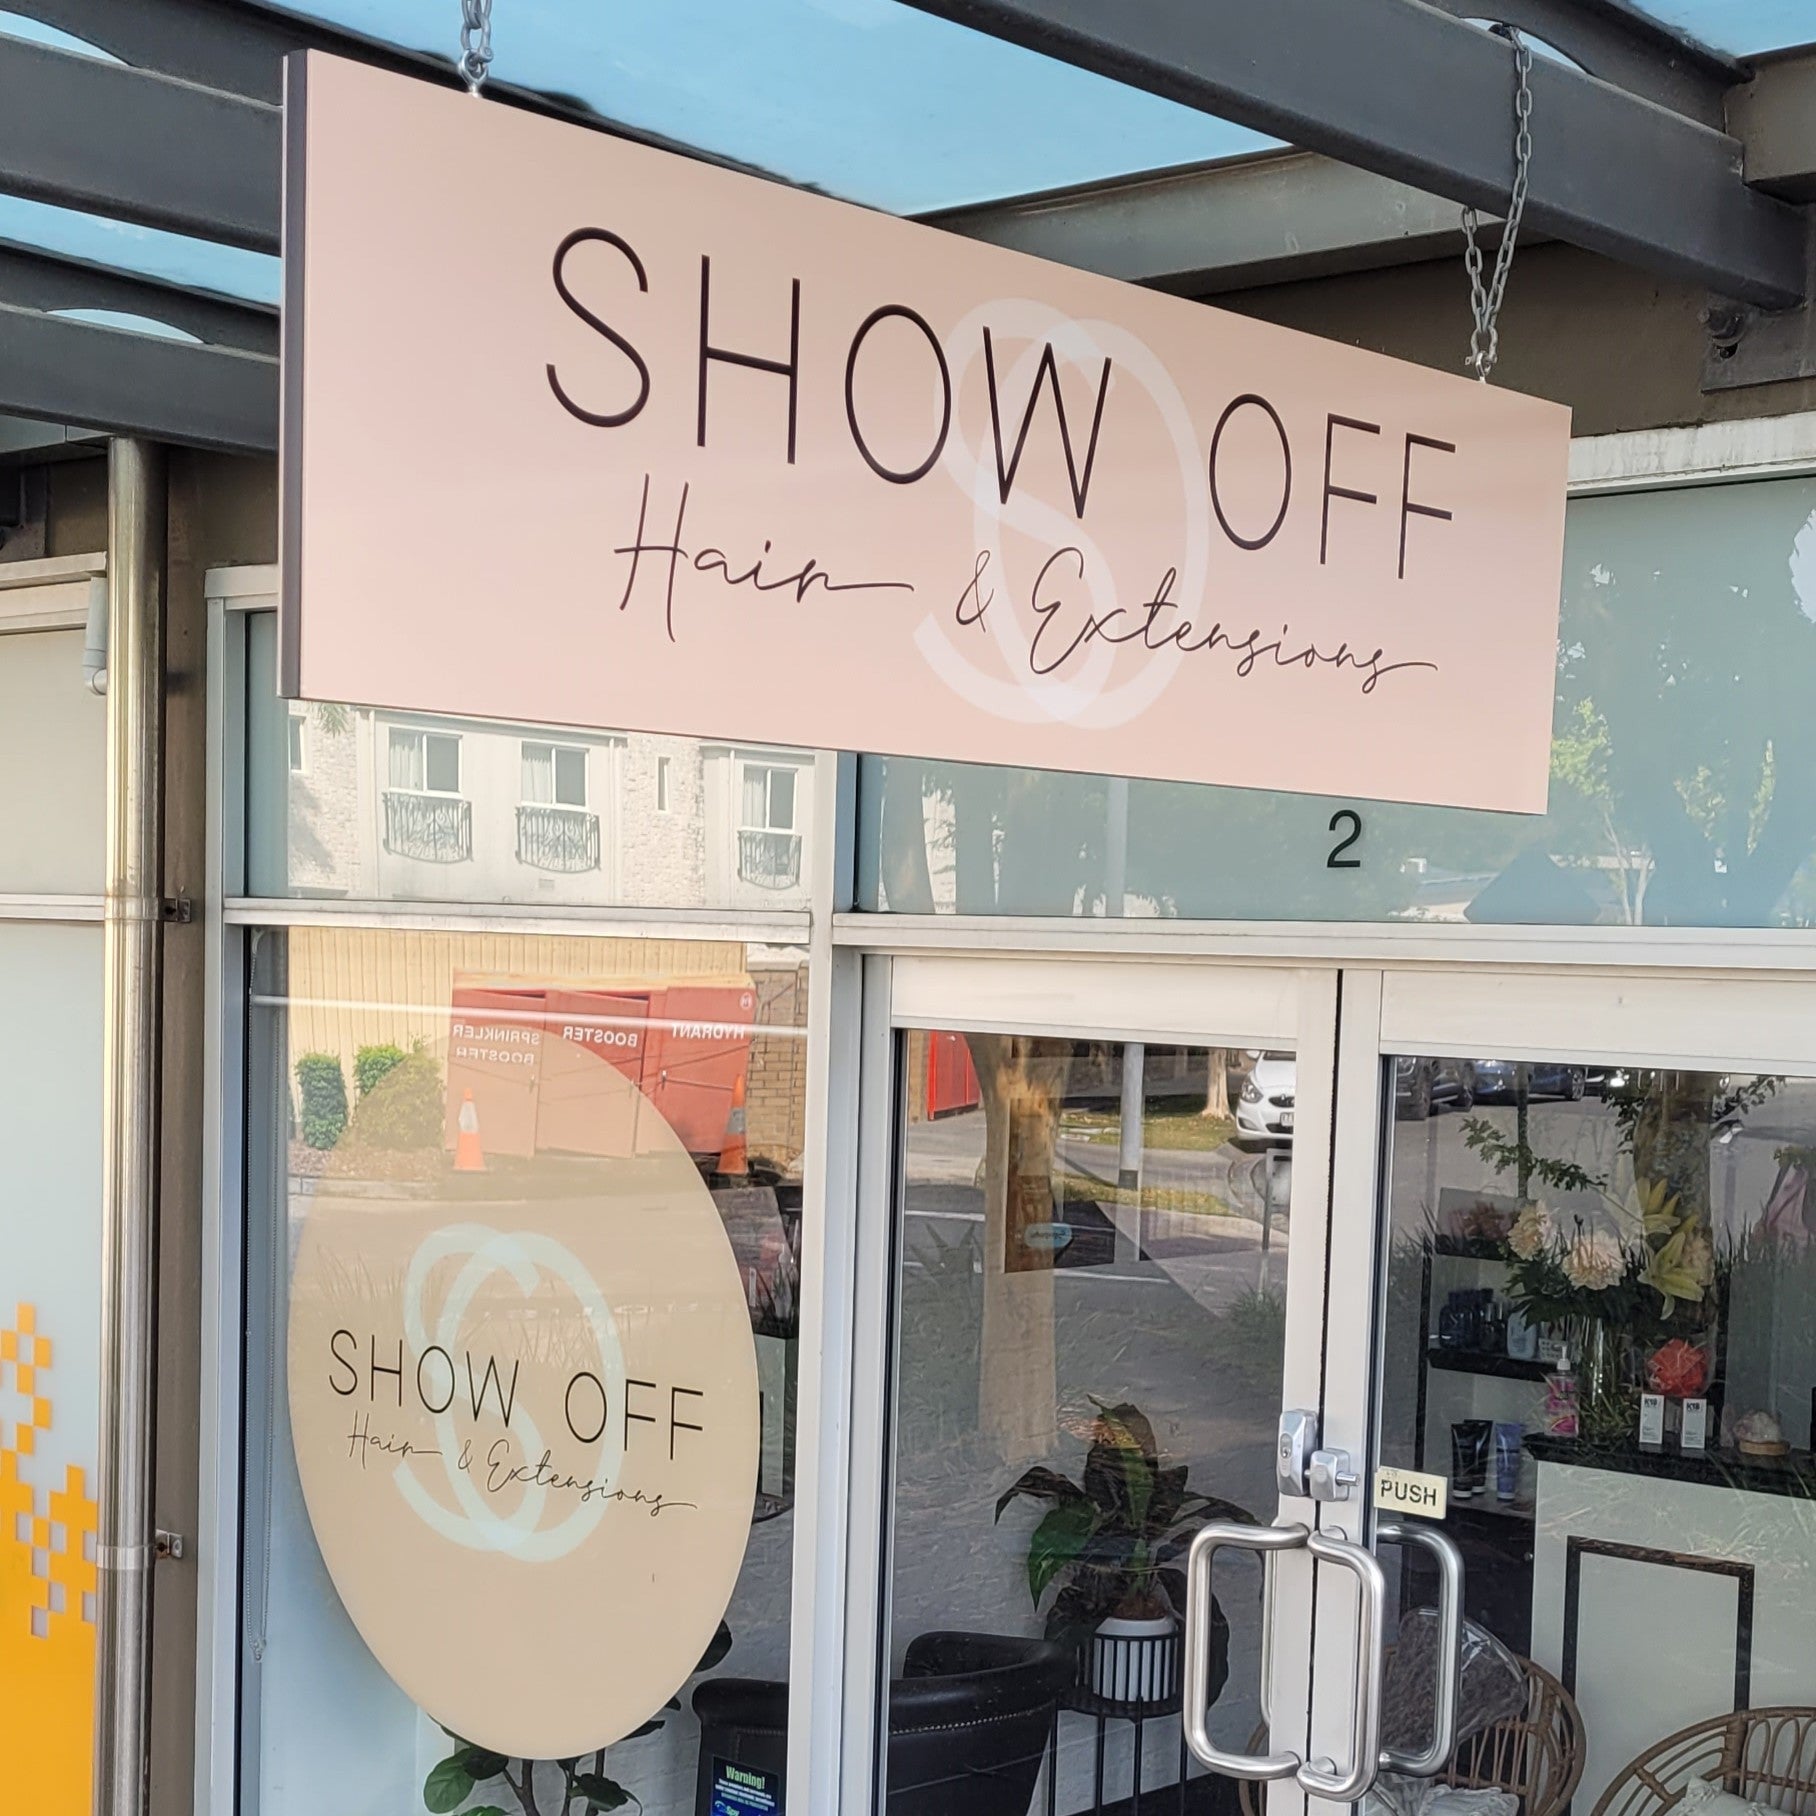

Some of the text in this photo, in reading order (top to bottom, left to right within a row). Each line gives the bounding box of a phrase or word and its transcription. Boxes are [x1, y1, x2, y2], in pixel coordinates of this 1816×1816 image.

[546, 227, 1456, 579] SHOW OFF
[614, 473, 1438, 694] Hair & Extensions
[1327, 809, 1362, 868] 2
[329, 1329, 704, 1460] SHOW OFF
[347, 1410, 697, 1517] Hair & Extensions
[1381, 1479, 1437, 1507] PUSH
[726, 1765, 766, 1790] Warning!
